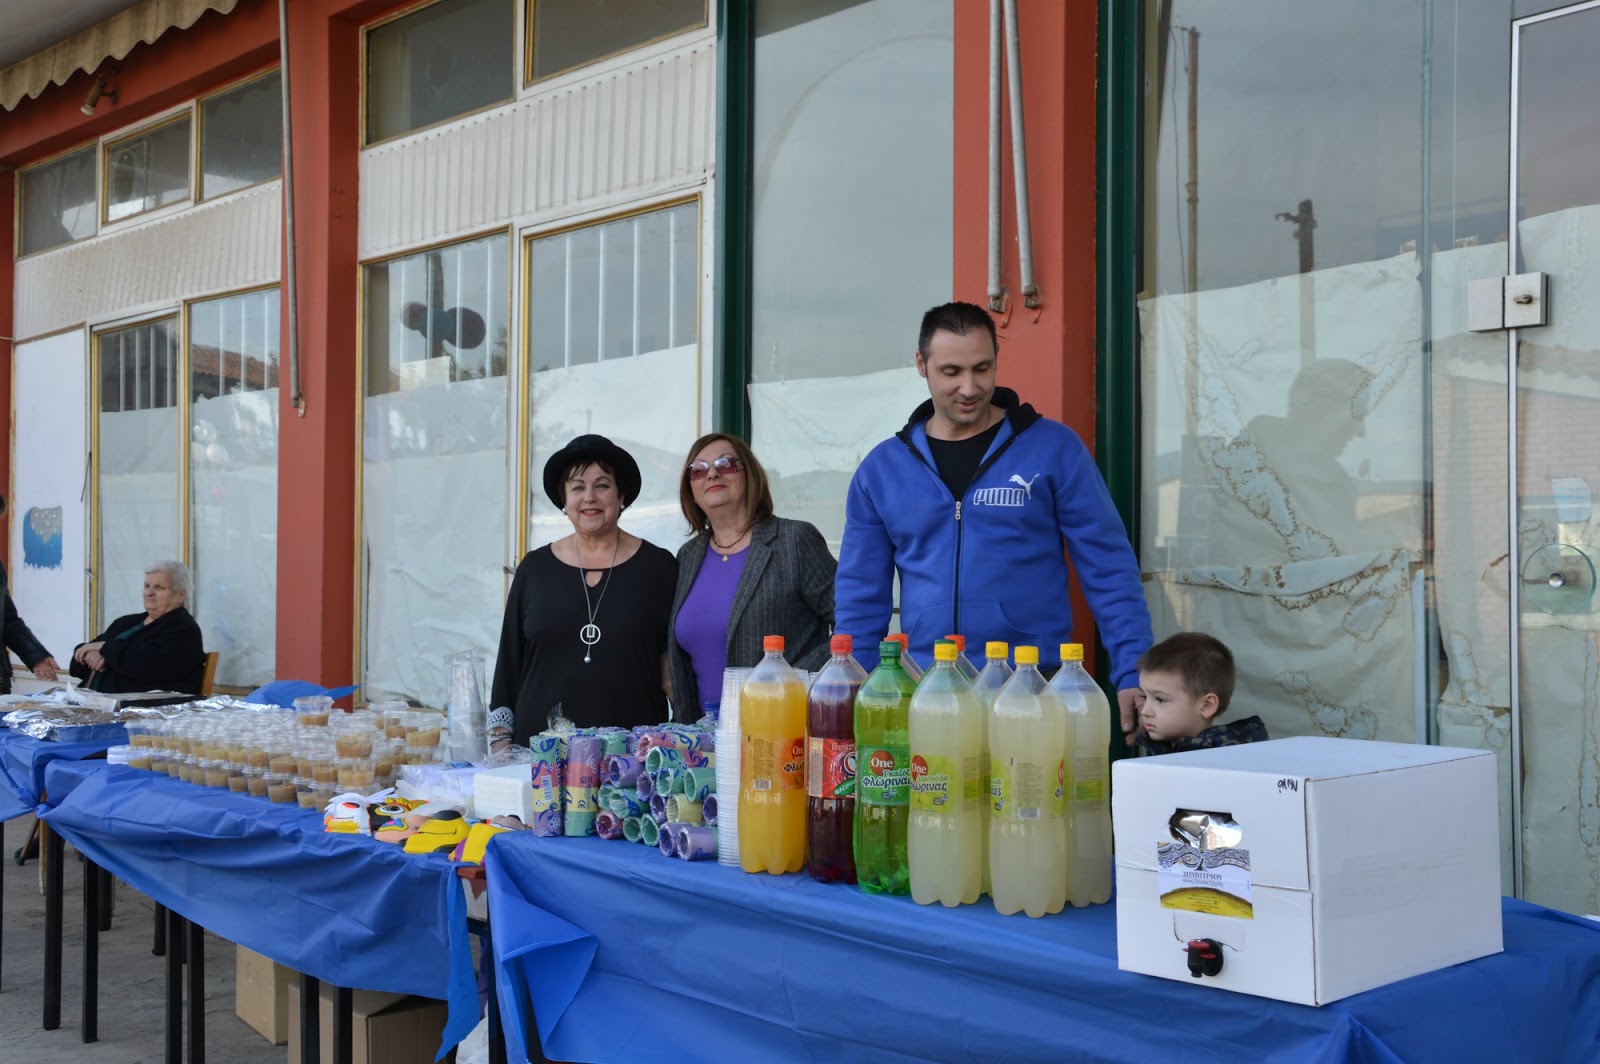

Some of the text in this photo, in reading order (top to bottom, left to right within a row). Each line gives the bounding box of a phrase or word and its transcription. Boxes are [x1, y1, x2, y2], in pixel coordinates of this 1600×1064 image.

[973, 488, 1025, 507] PUMA
[792, 745, 805, 756] On
[870, 757, 893, 768] One
[911, 762, 927, 774] One
